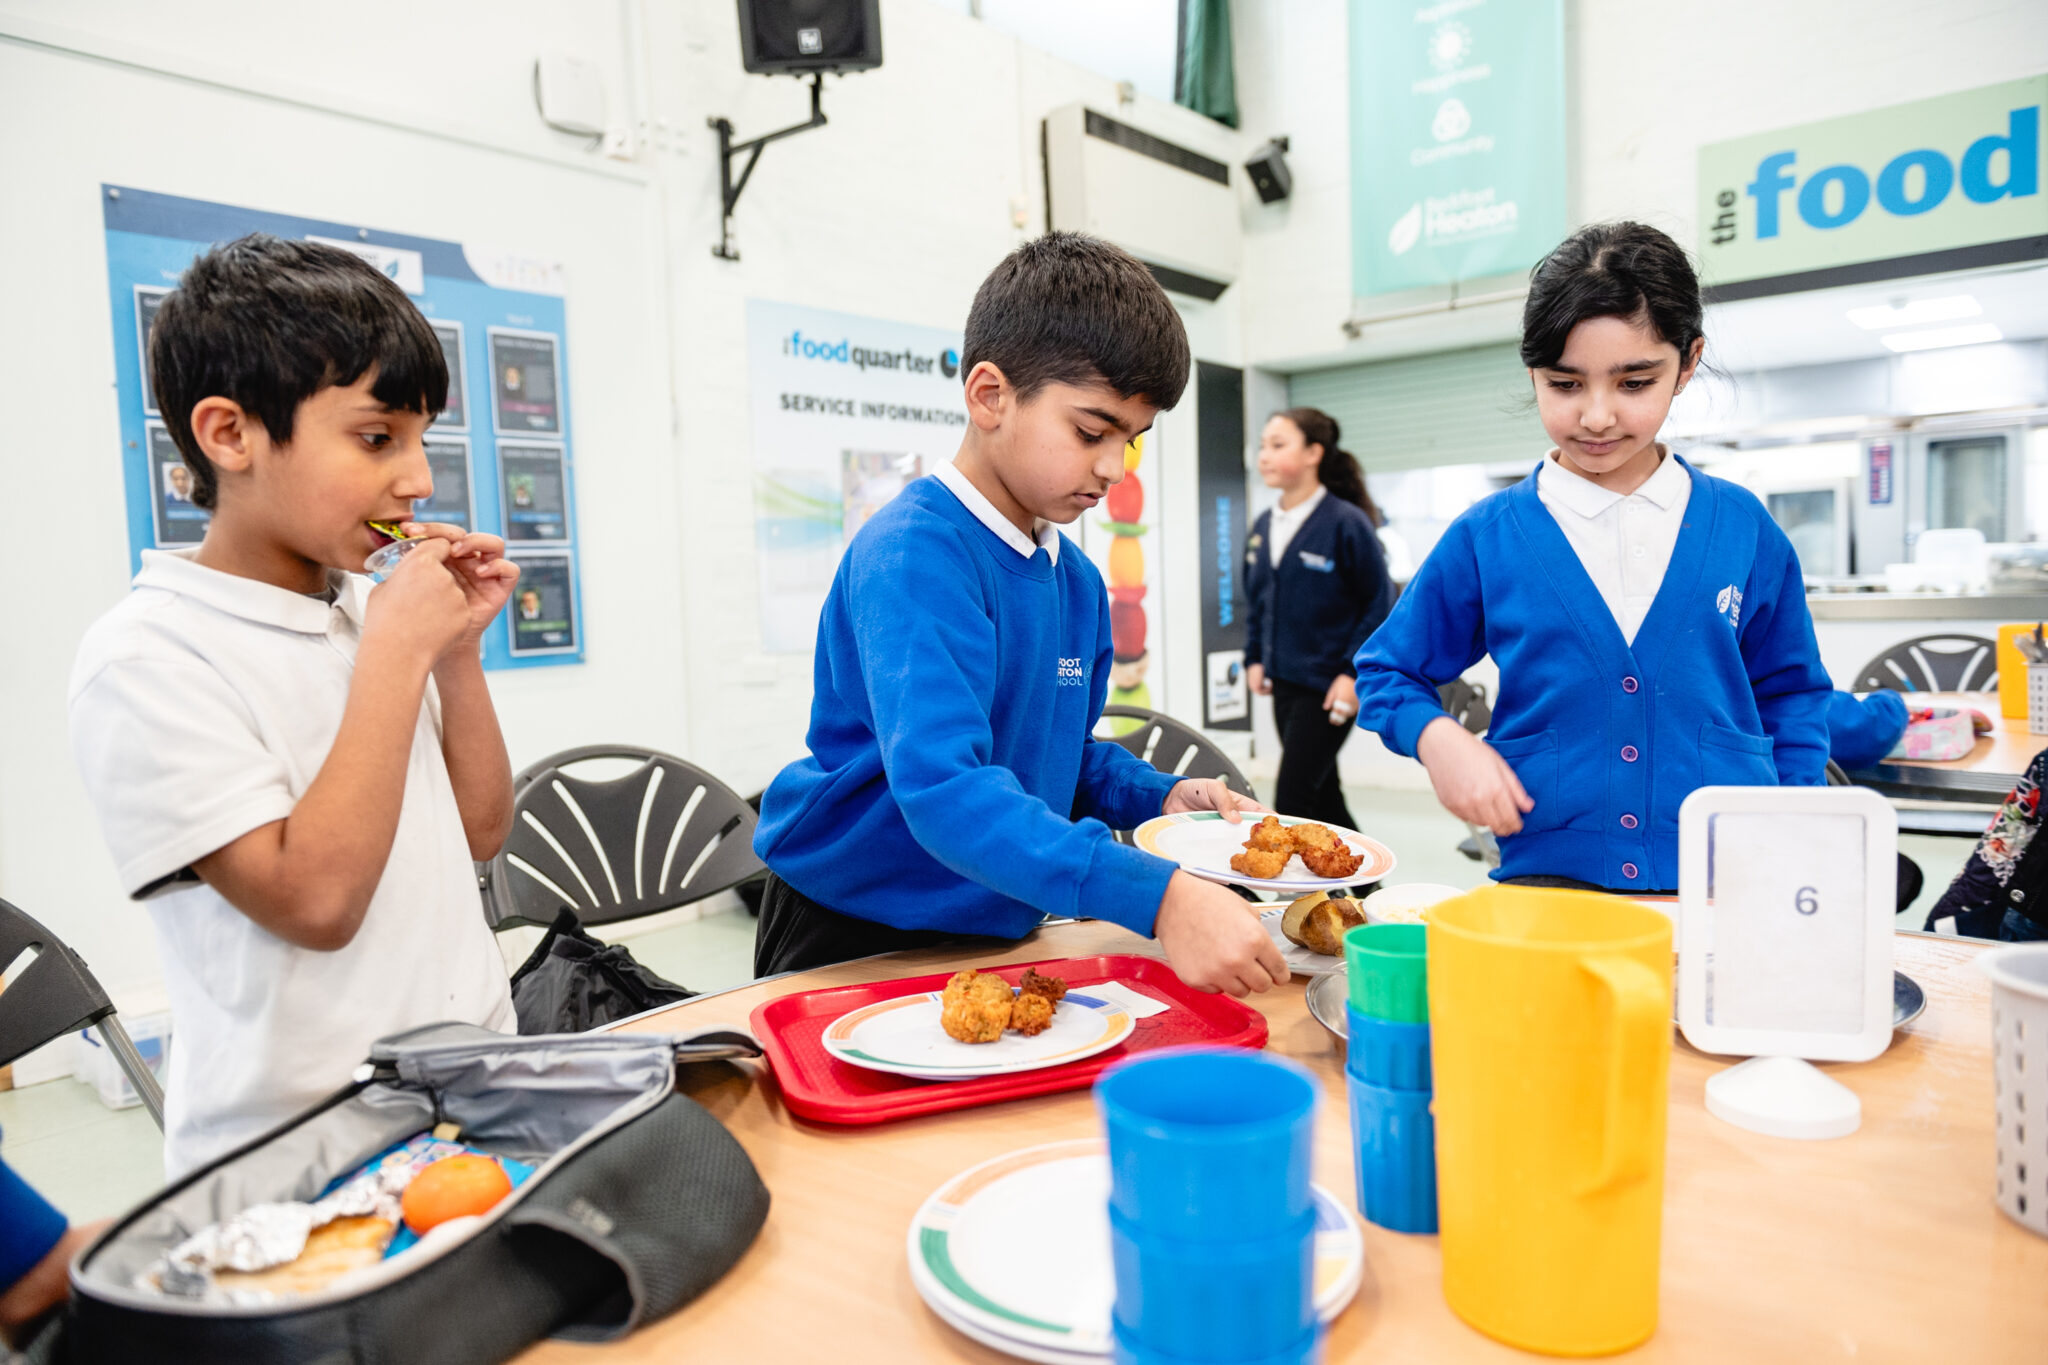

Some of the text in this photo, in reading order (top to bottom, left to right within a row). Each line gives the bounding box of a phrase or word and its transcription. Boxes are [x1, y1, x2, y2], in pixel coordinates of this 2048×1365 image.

[1711, 104, 2041, 245] the food
[780, 394, 967, 426] SERVICE INFORMATION
[1217, 497, 1233, 627] WELCOME
[1794, 886, 1819, 915] 6
